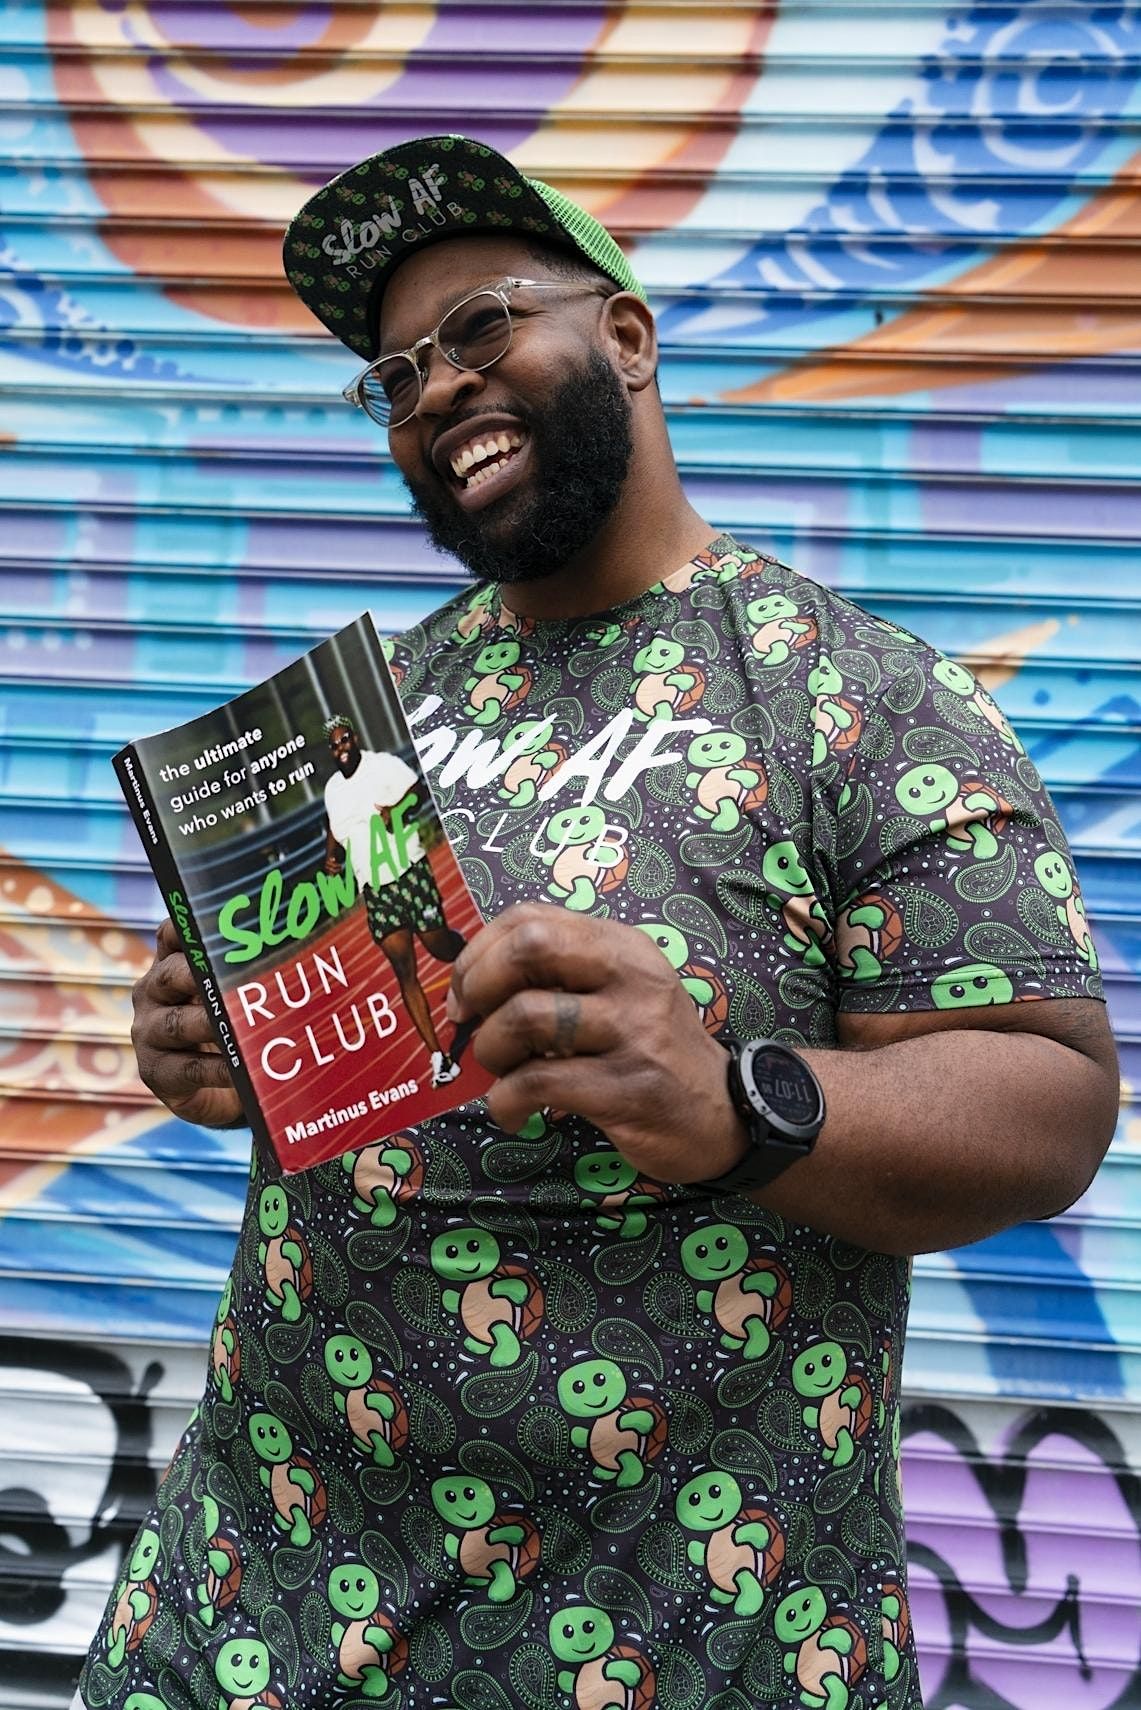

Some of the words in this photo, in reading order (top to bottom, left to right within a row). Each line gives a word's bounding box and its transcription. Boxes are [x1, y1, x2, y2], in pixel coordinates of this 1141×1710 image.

[408, 163, 445, 215] AF
[346, 245, 393, 279] RUN
[402, 202, 463, 242] CLUB
[159, 765, 191, 782] the
[193, 728, 263, 770] ultimate
[170, 781, 221, 813] guide
[223, 767, 247, 787] for
[250, 734, 306, 775] anyone
[537, 707, 712, 808] AF
[123, 757, 146, 809] Martinus
[142, 809, 159, 845] Evans
[178, 813, 218, 836] who
[221, 788, 267, 819] wants
[268, 781, 287, 795] to
[288, 762, 315, 785] run
[370, 793, 419, 891] AF
[190, 949, 209, 973] AF
[203, 978, 222, 1017] RUN
[219, 1022, 240, 1068] CLUB
[236, 945, 349, 1027] RUN
[261, 992, 398, 1081] CLUB
[284, 1099, 368, 1144] Martinus
[368, 1078, 419, 1111] Evans
